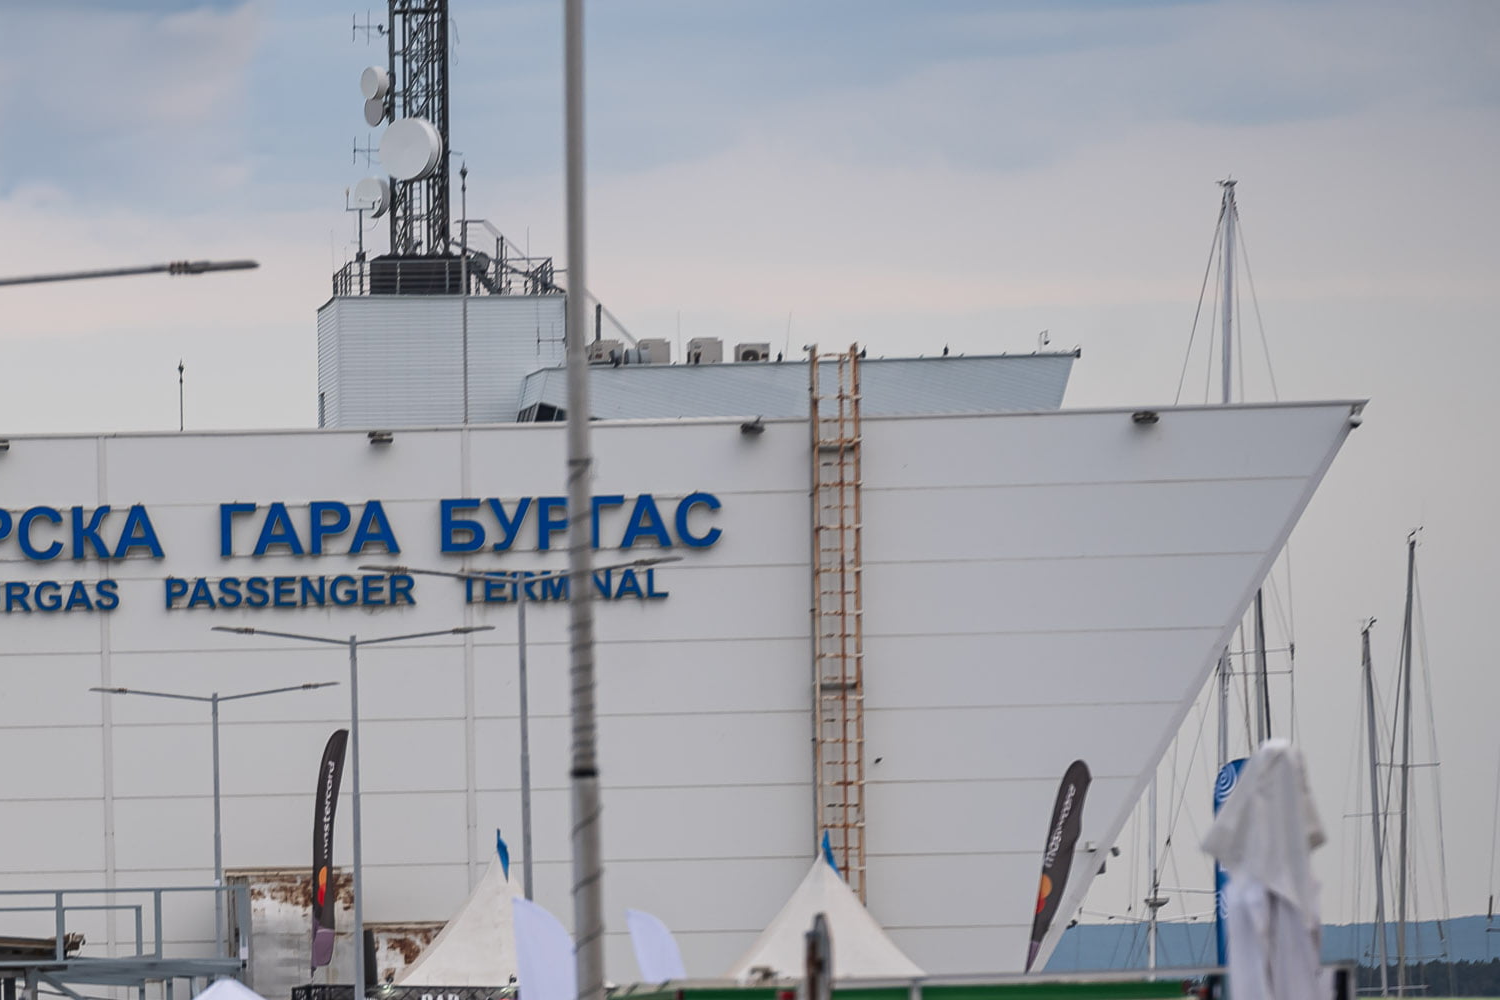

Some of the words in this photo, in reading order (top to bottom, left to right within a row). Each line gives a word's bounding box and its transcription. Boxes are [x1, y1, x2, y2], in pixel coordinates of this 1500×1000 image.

[219, 500, 401, 557] ГАРА
[440, 492, 723, 552] БУРГАС
[165, 573, 416, 610] PASSENGER
[463, 568, 669, 603] TERMNAL
